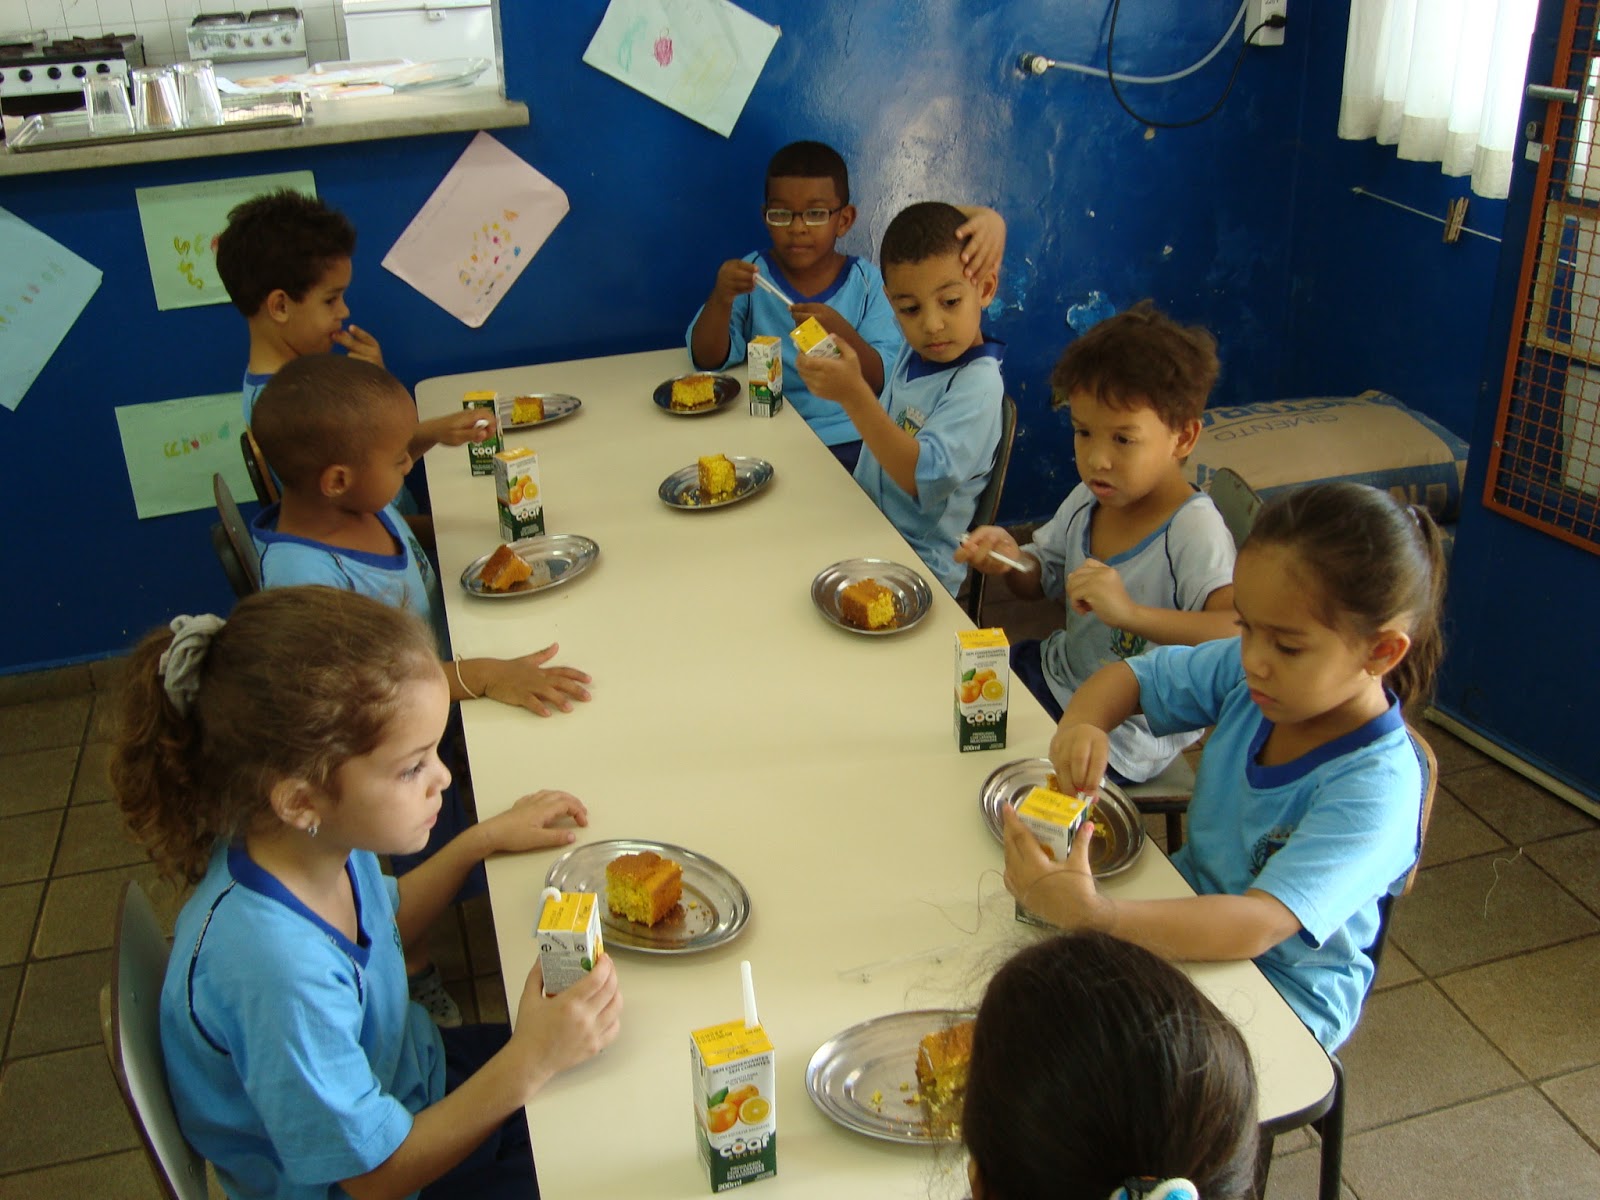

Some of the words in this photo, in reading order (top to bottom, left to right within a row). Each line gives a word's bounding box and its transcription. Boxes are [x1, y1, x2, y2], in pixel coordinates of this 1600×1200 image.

[1214, 414, 1339, 441] CIMENTO
[966, 709, 1002, 724] coaf
[720, 1132, 770, 1158] coaf
[717, 1179, 742, 1191] 200ml
